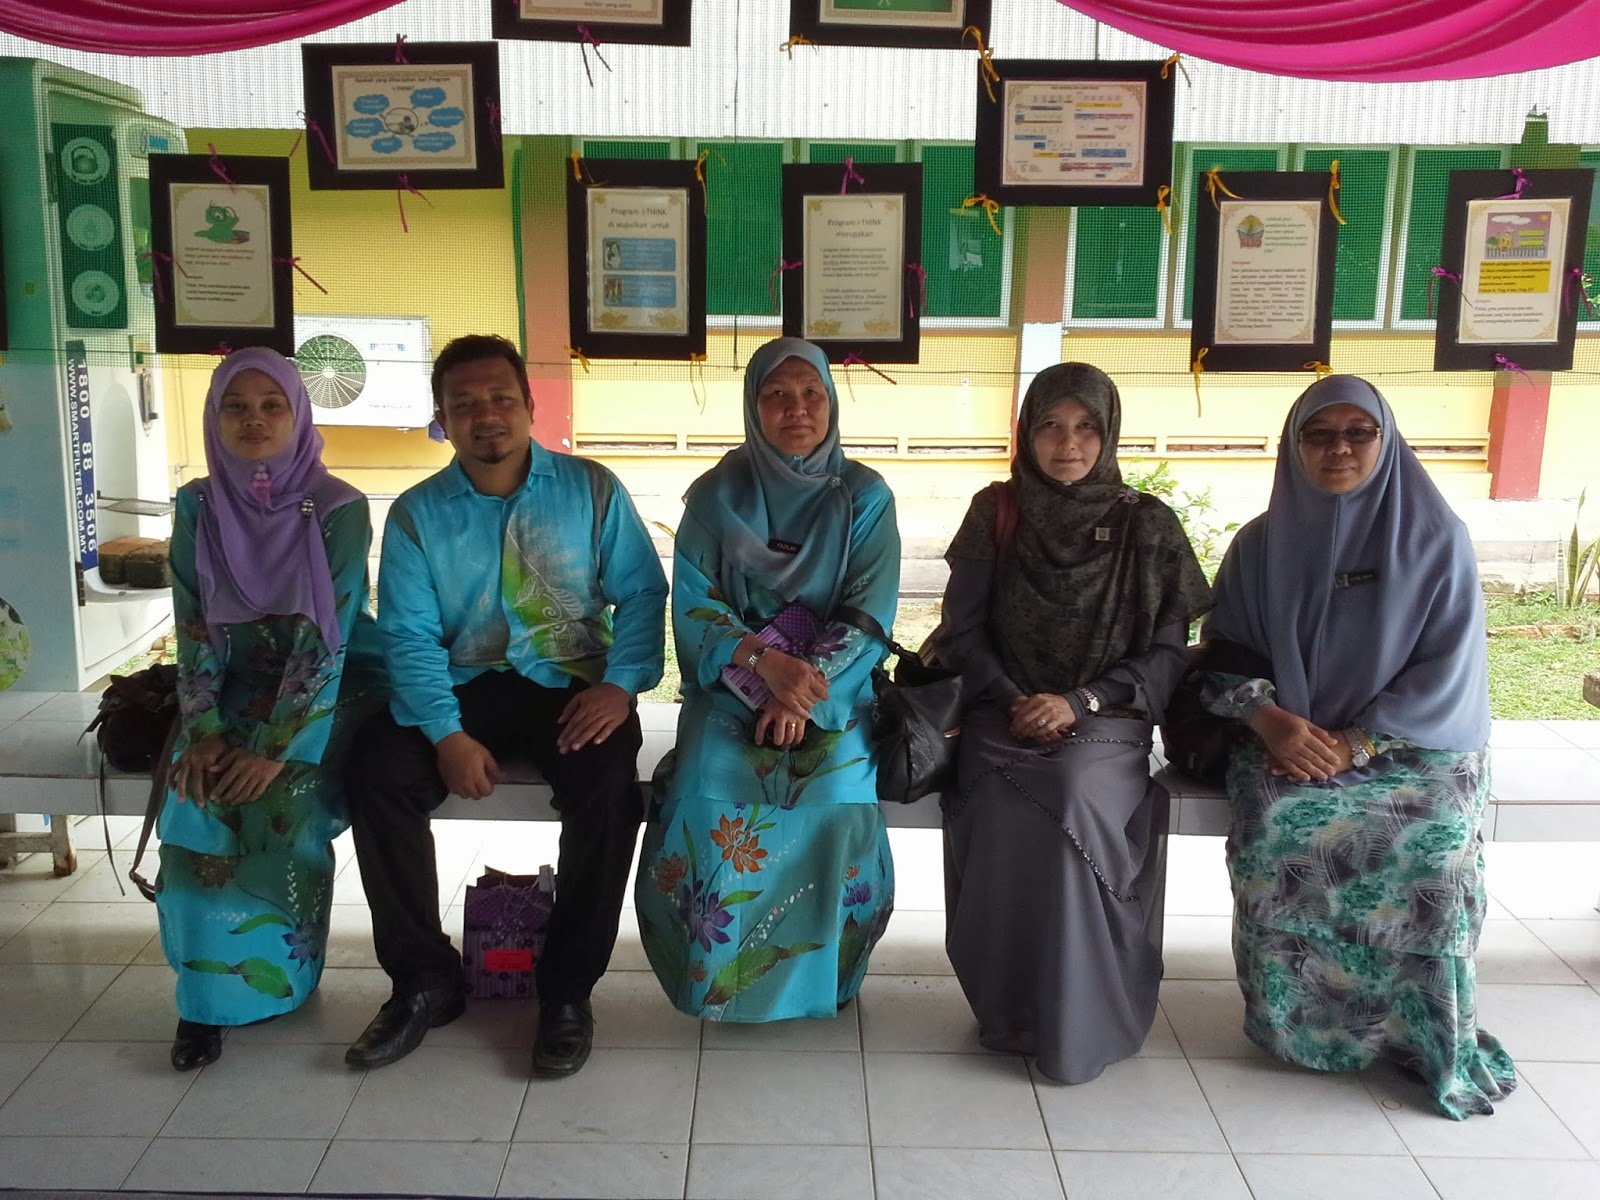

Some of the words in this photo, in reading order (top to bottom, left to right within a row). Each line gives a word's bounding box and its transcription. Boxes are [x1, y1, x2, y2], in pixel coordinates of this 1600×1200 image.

[611, 208, 639, 216] Program
[616, 221, 648, 230] wujudkan
[827, 219, 856, 227] Program
[836, 231, 873, 239] merupakan
[68, 358, 88, 554] WWW.SMARTFILTER.COM.MY
[82, 441, 93, 471] 88
[85, 493, 97, 552] 3506
